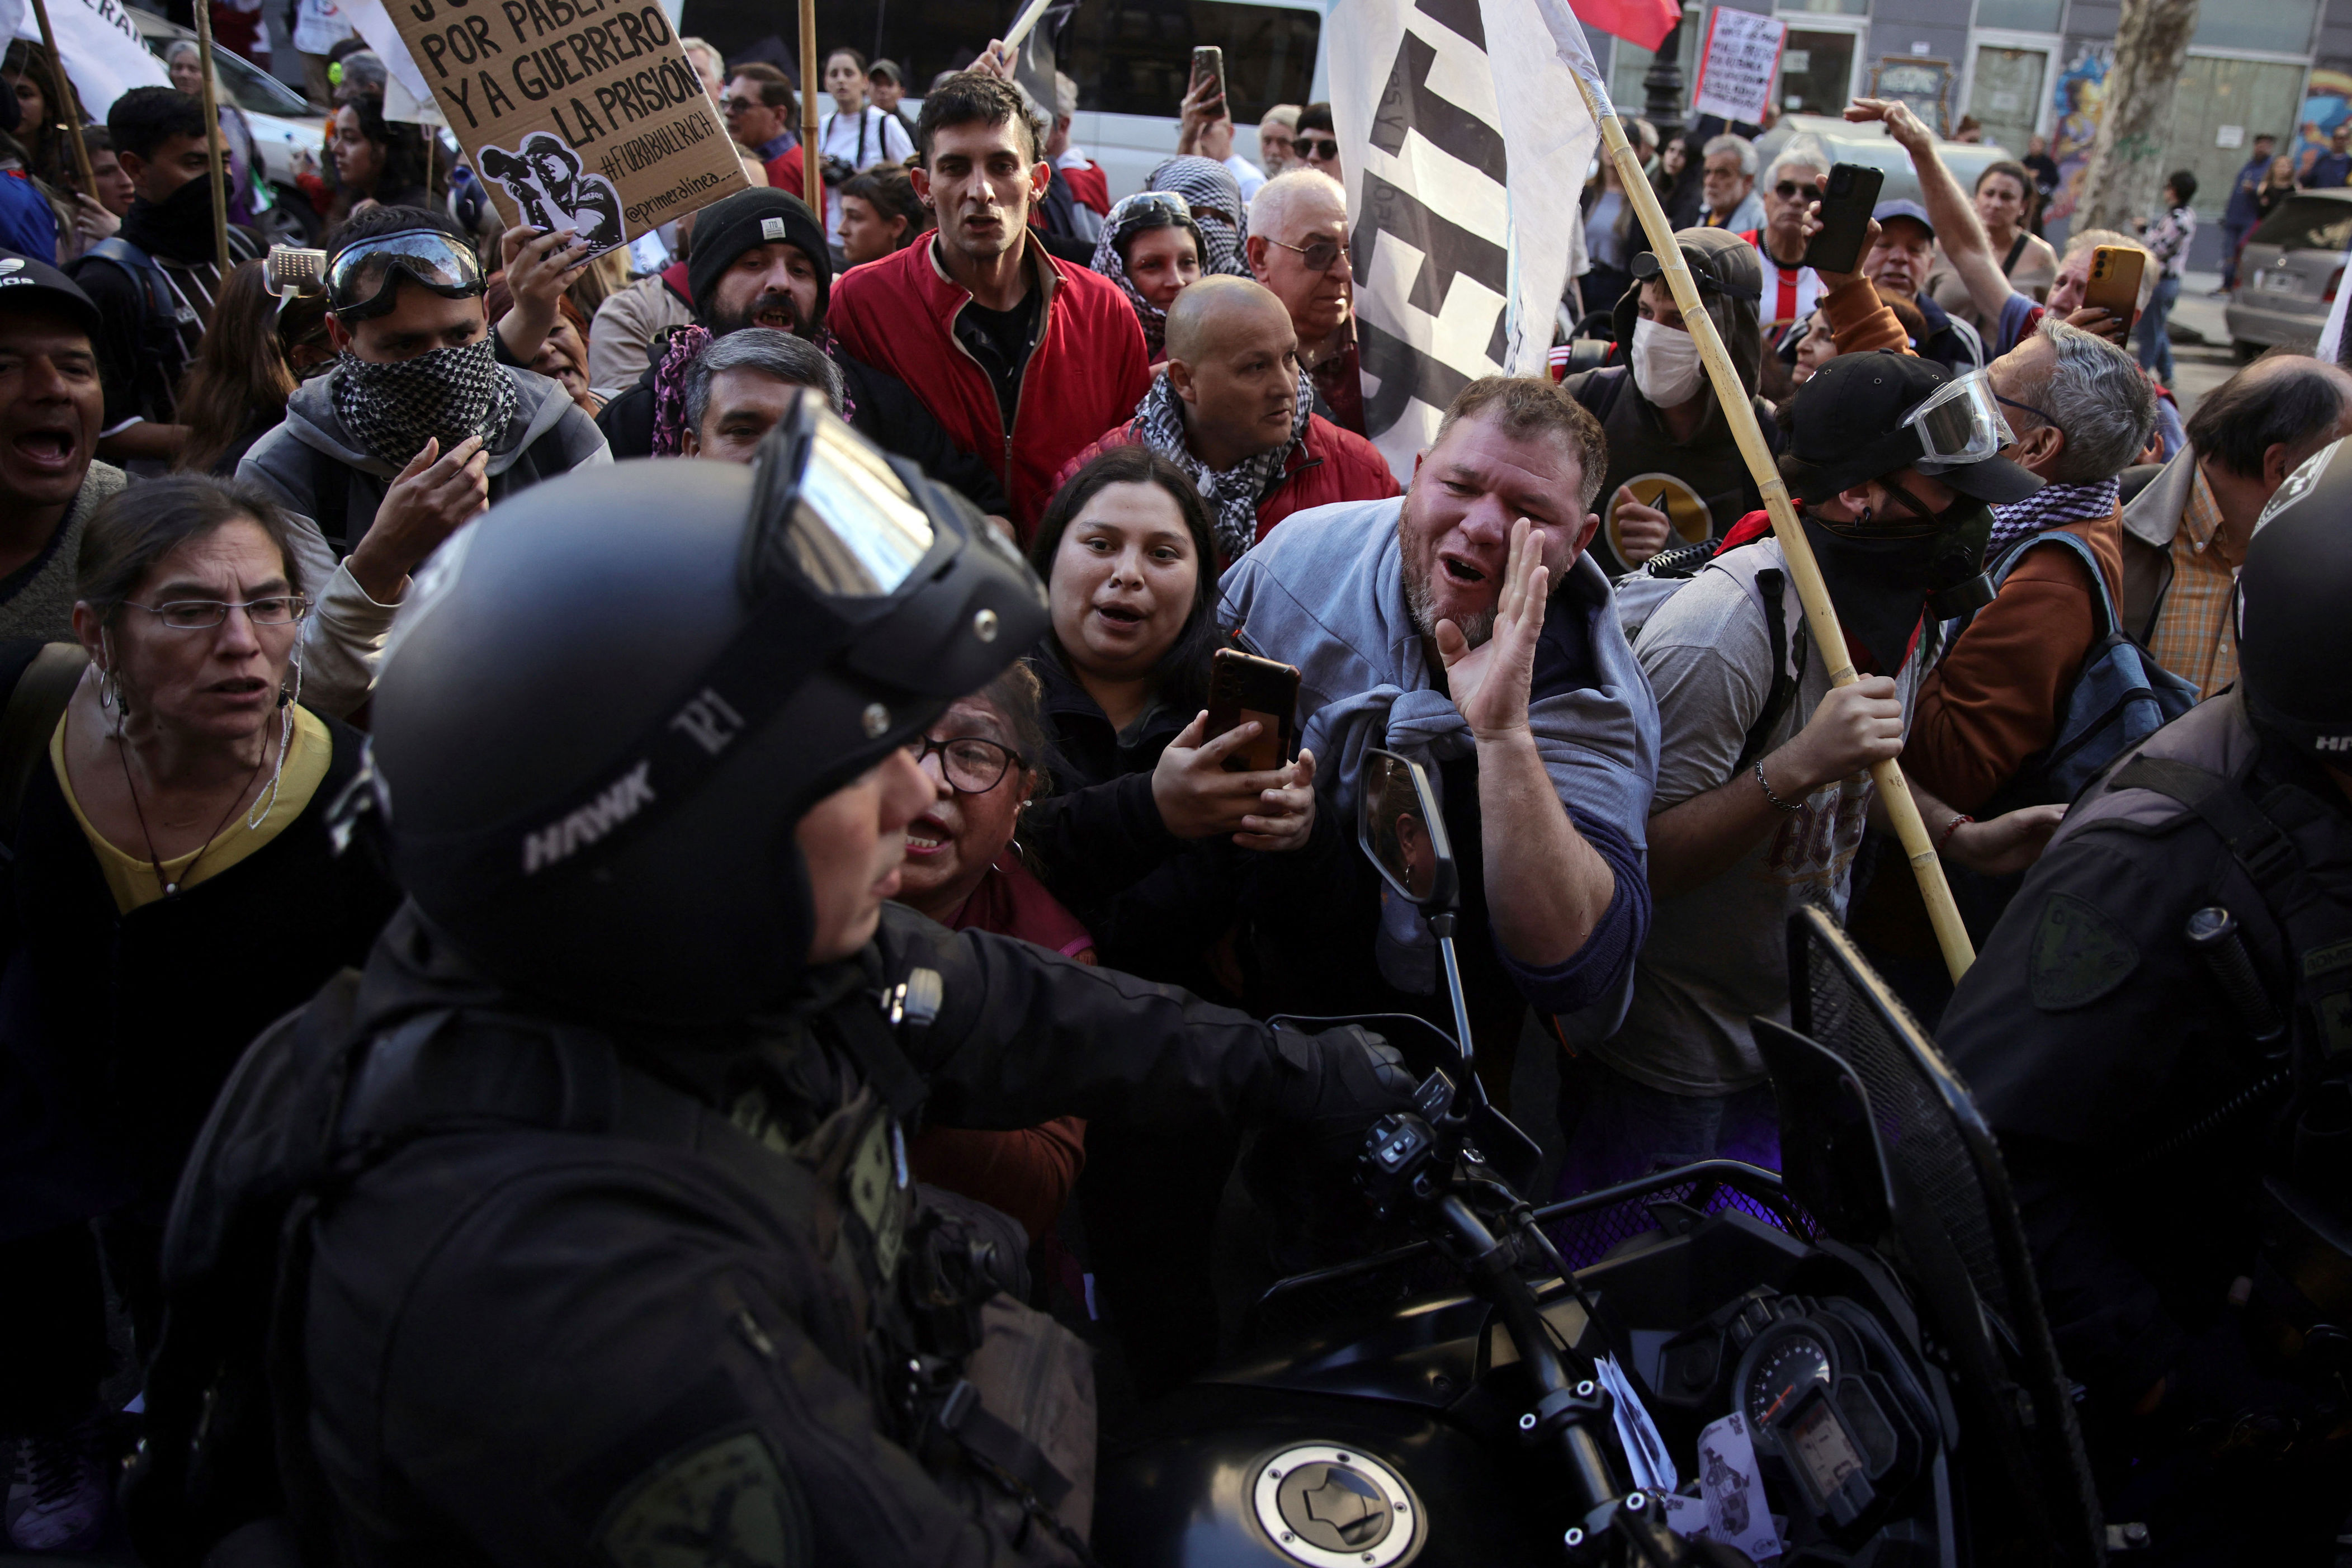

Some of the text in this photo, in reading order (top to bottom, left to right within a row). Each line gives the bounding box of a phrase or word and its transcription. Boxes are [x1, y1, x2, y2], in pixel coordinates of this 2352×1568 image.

[420, 15, 502, 78] POR
[512, 6, 671, 101] GUERRERO
[550, 55, 703, 149] LA PRISIÓN
[600, 110, 715, 183] #FUERABULLRICH
[523, 759, 655, 875] HAWK
